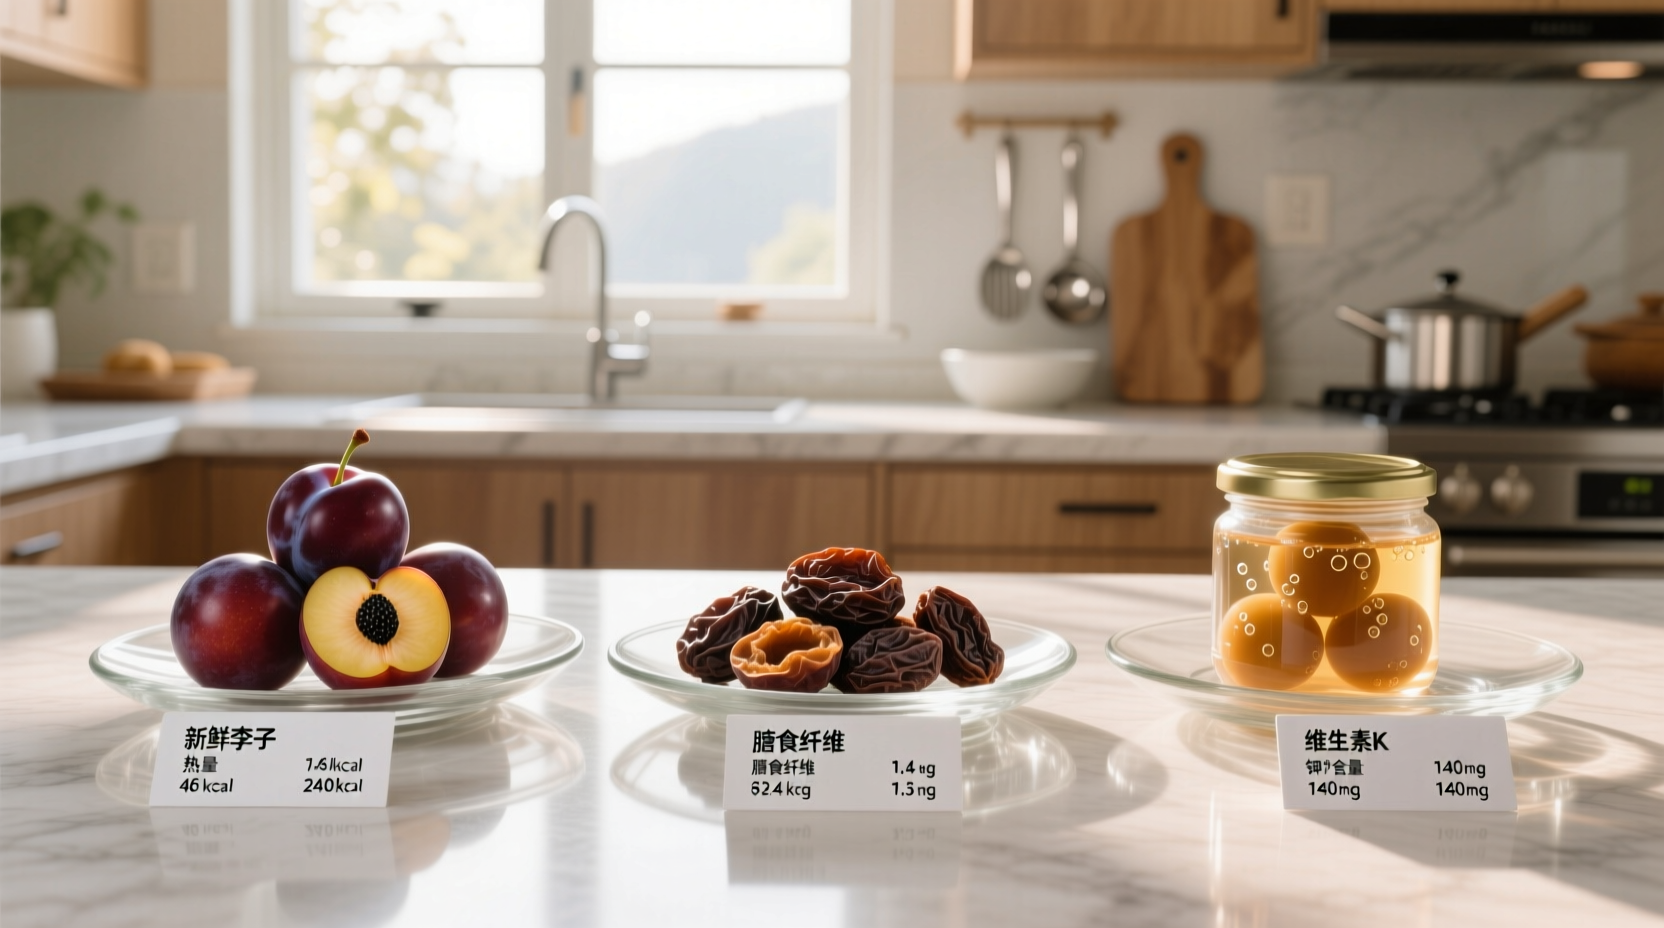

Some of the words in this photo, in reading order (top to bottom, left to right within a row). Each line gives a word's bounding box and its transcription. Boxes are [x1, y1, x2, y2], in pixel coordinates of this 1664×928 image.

[184, 725, 276, 751] 新鲜李子
[1305, 728, 1389, 753] 维生素K
[1434, 760, 1486, 778] 140mg
[1309, 781, 1360, 800] 140mg
[1436, 782, 1489, 801] 140mg
